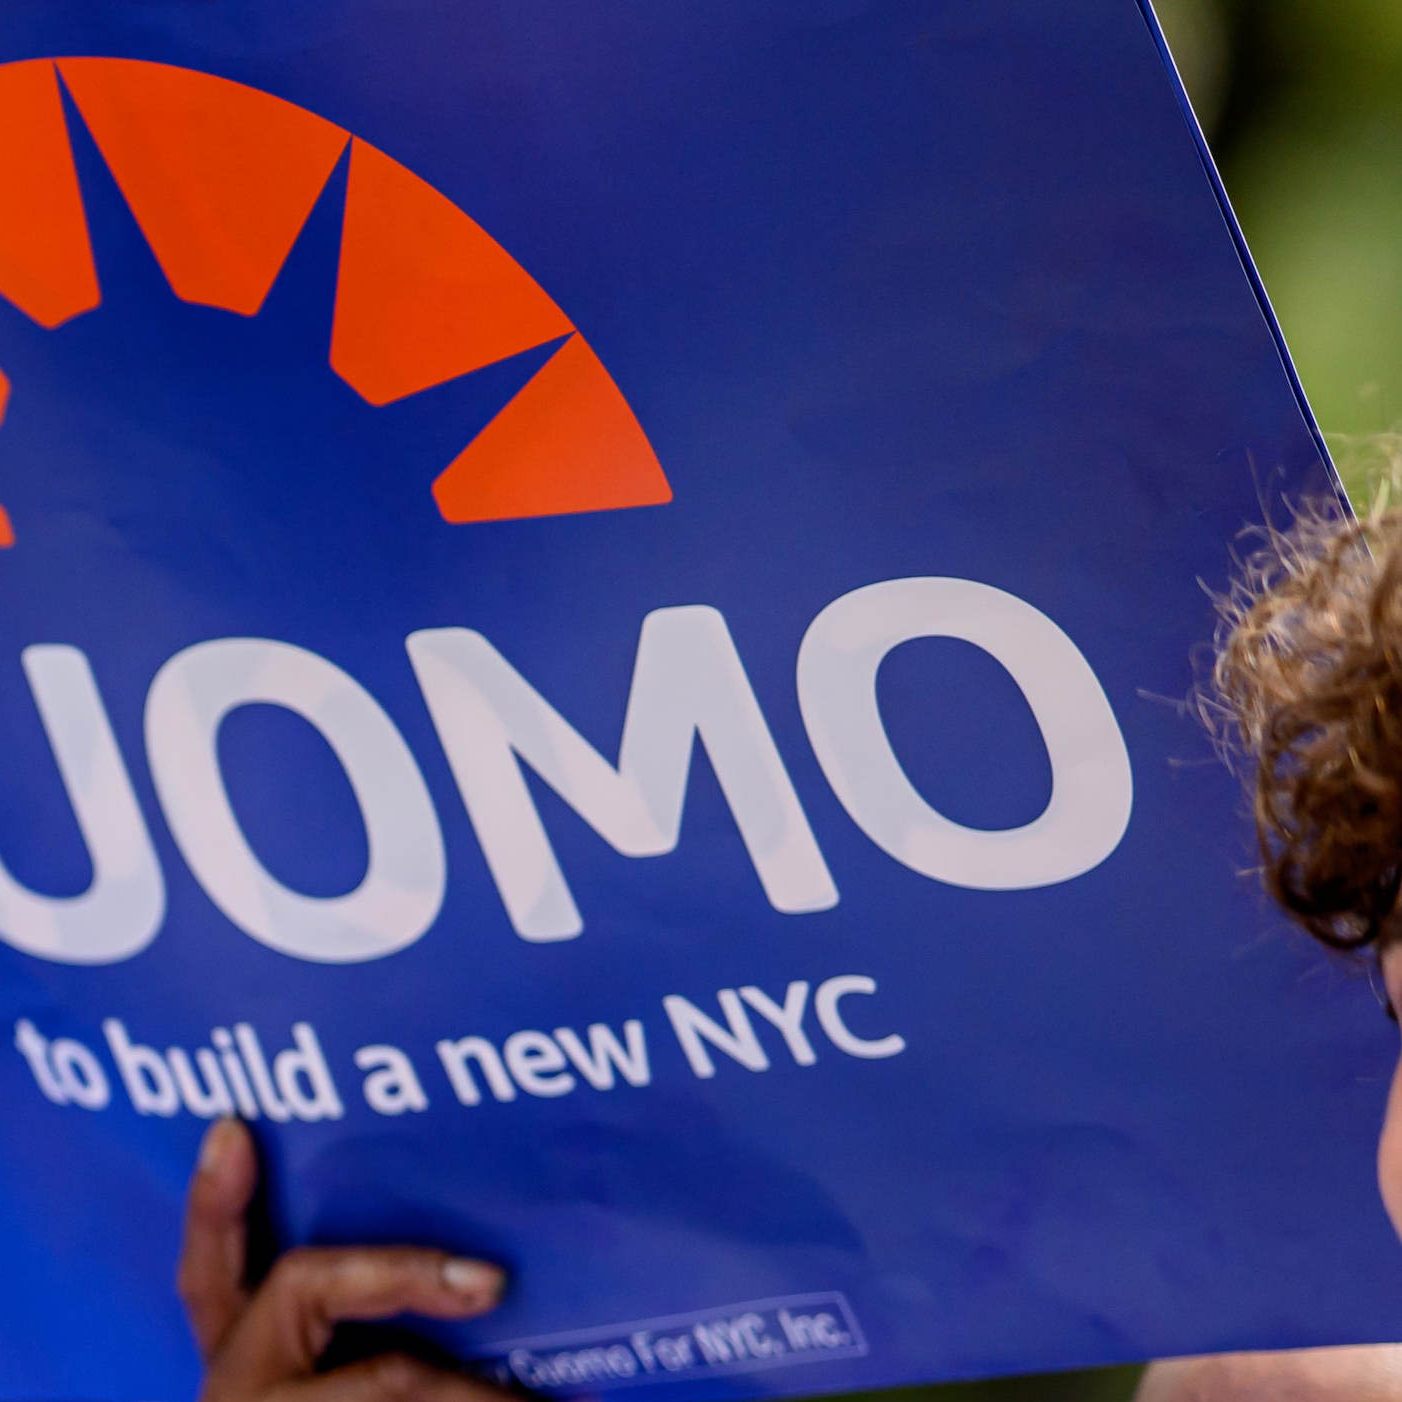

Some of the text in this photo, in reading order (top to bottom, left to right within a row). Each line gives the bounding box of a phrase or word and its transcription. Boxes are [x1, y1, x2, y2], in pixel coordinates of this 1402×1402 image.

[14, 973, 907, 1123] to build a new NYC
[508, 1345, 638, 1388] Cuomo
[779, 1308, 851, 1350] Inc.
